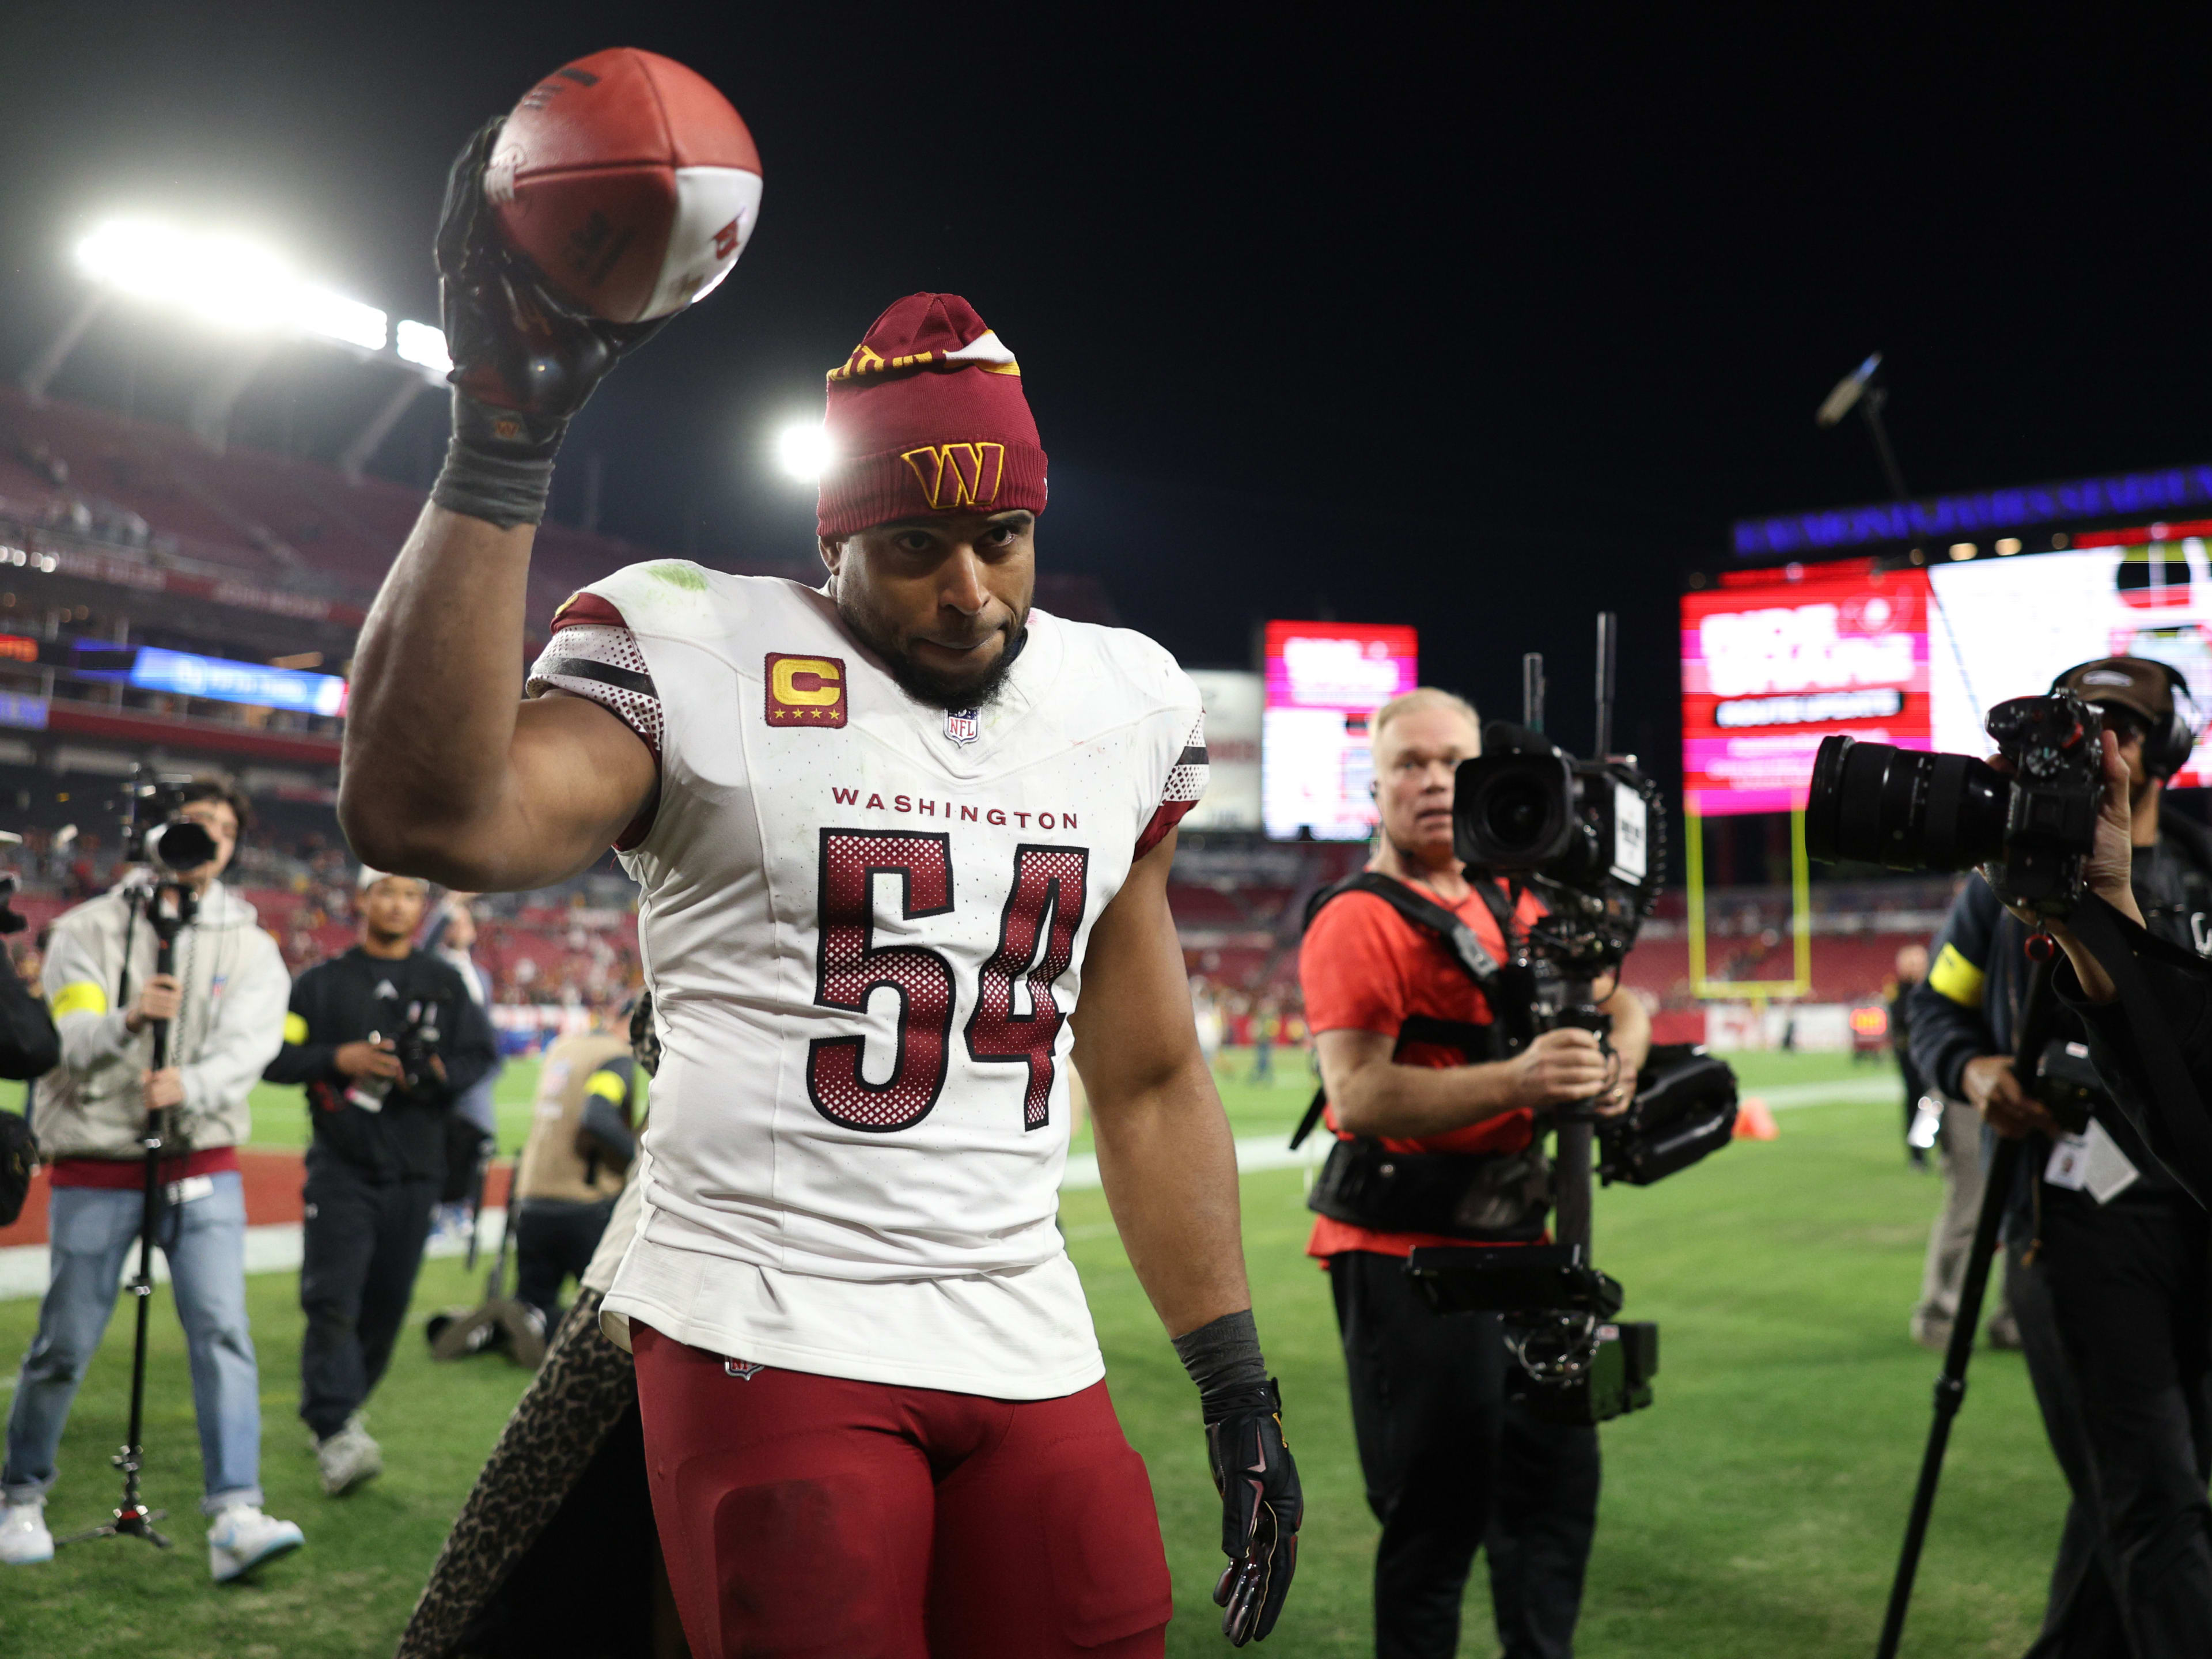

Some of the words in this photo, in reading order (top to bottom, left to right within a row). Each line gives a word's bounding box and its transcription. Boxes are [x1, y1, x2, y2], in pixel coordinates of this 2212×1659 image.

[900, 442, 1005, 509] W
[772, 658, 840, 706] C
[949, 718, 974, 737] NFL
[832, 786, 1078, 830] WASHINGTON
[806, 827, 1089, 1133] 54
